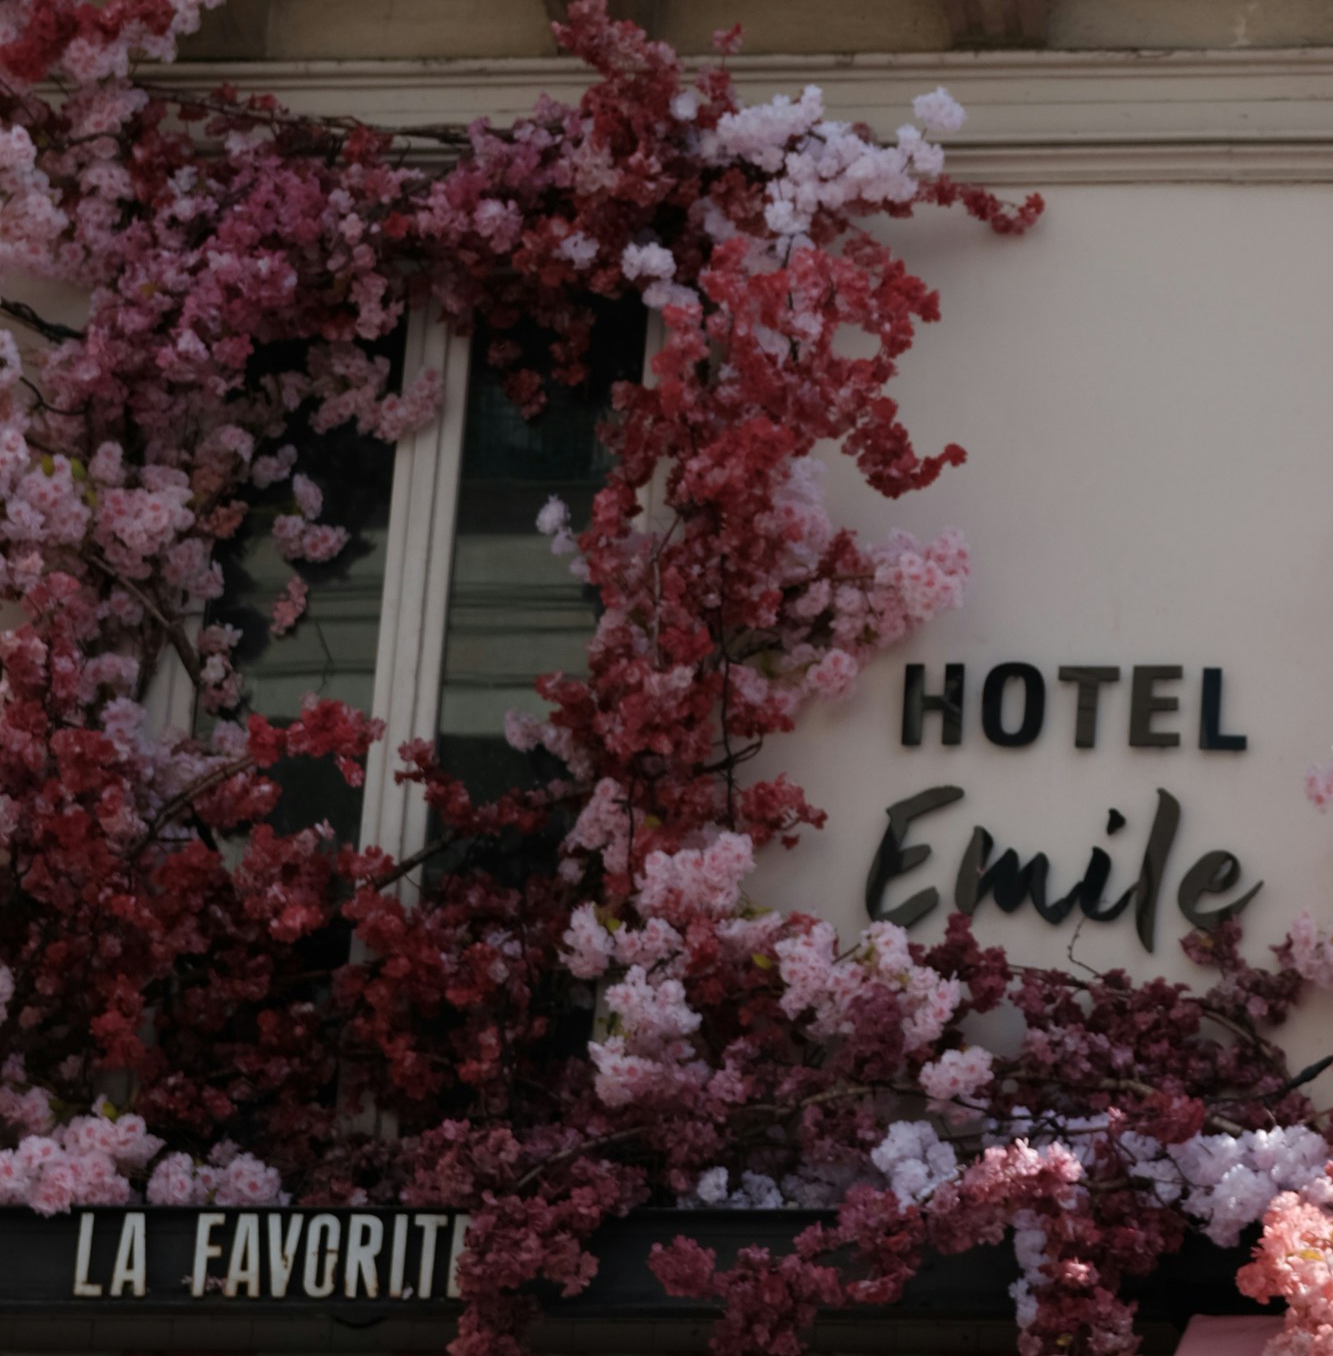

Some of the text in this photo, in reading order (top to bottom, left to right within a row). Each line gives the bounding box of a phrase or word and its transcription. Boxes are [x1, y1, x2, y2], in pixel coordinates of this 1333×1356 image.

[900, 661, 1248, 752] HOTEL
[865, 784, 1264, 954] Emile
[73, 1211, 146, 1298] LA
